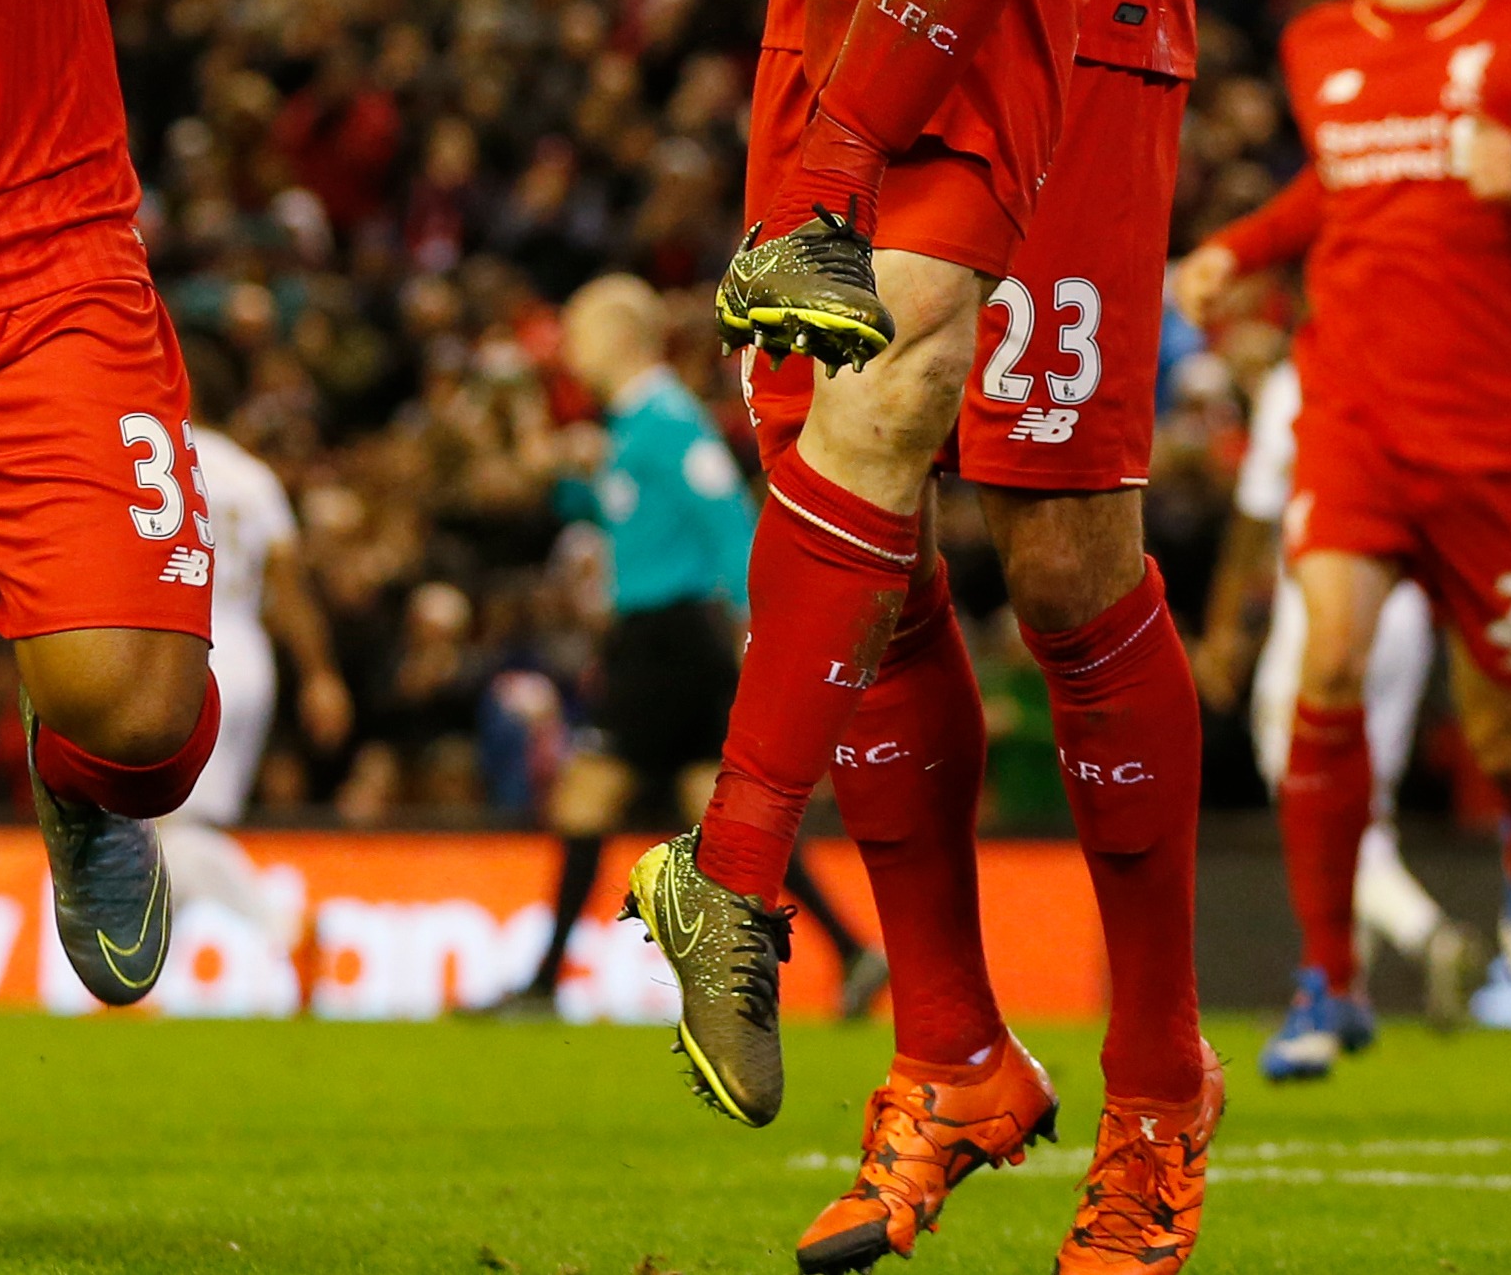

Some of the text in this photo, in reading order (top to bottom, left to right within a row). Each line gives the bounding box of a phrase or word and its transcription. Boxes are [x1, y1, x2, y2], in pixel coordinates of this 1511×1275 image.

[983, 276, 1102, 405] 23
[1007, 407, 1080, 443] NB
[158, 545, 210, 587] NB
